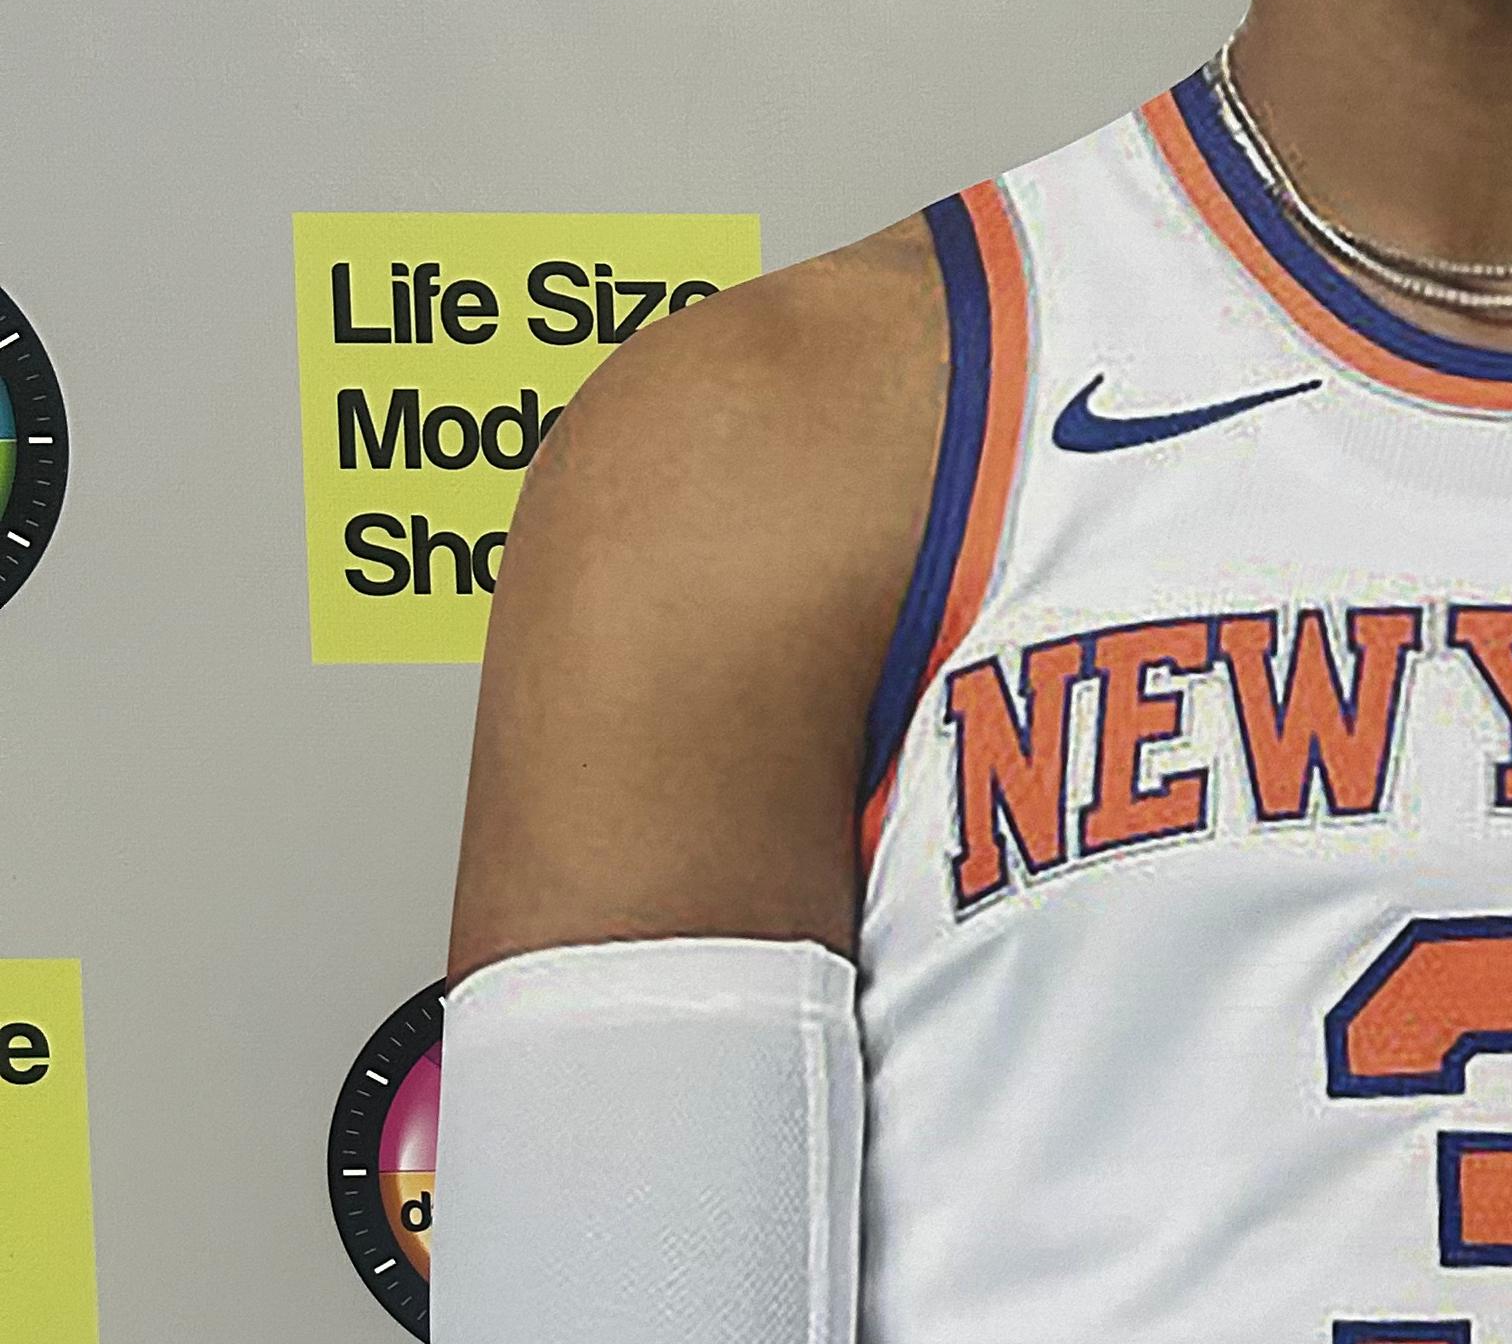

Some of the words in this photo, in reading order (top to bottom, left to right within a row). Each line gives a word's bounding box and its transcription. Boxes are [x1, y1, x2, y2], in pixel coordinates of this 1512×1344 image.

[331, 262, 499, 345] Life
[337, 388, 564, 470] Mod
[944, 604, 1421, 911] NEW
